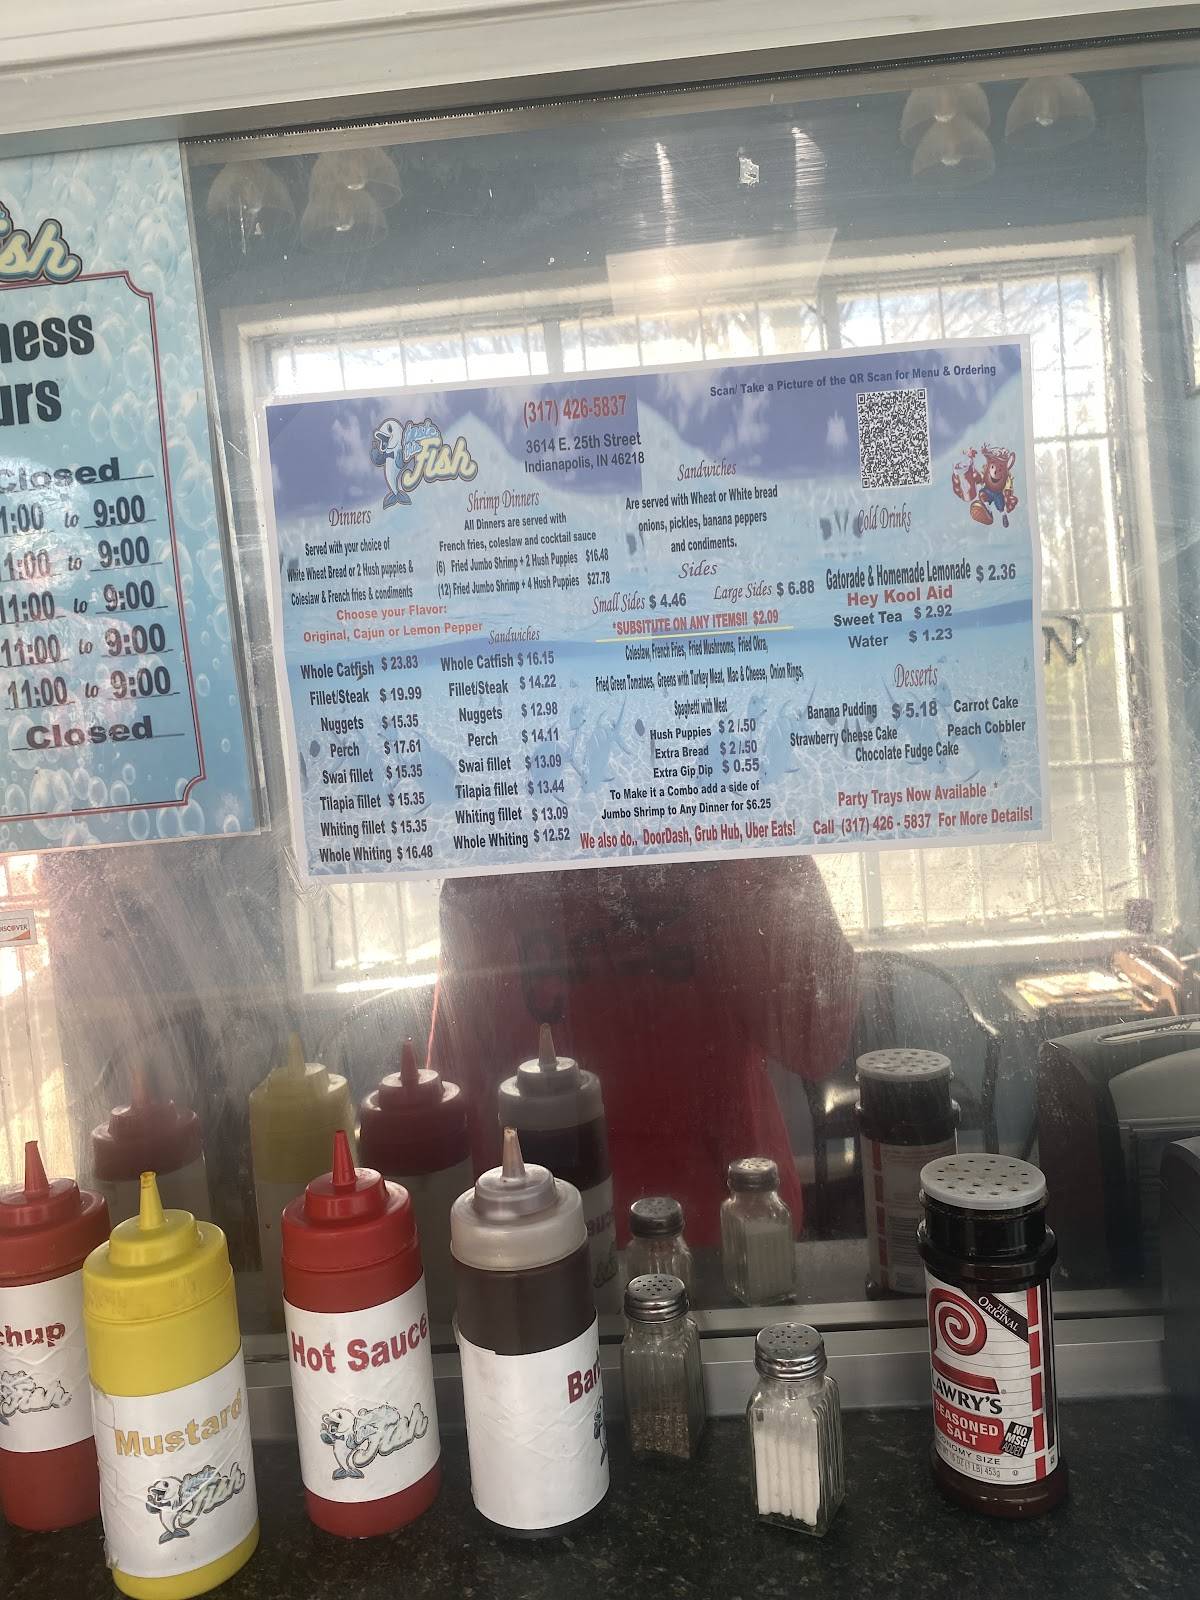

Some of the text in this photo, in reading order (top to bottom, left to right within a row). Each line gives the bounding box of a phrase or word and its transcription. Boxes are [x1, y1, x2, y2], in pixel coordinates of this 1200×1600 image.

[710, 364, 997, 396] Scan/ Take Picture Scan Menu Ordering
[524, 395, 626, 428] (317) 426-5837
[526, 432, 642, 454] 3614 25th Street
[525, 452, 644, 472] Indianapolis, 46218
[677, 458, 737, 481] Sandwiches
[467, 489, 540, 515] Shrimp Dinners
[642, 485, 778, 508] served Wheat White bread
[64, 512, 80, 528] to
[93, 495, 146, 527] 9:00
[328, 506, 372, 526] Dinners
[477, 514, 548, 529] Dinners served
[880, 503, 912, 533] Drinks
[439, 531, 596, 551] French fries, coleslaw cocktail sauce
[68, 555, 82, 571] to
[98, 536, 150, 568] 9:00
[678, 560, 718, 579] Sides
[826, 558, 971, 591] Gatorade Homemade Lemonade
[74, 598, 88, 614] to
[104, 580, 155, 612] 9:00
[592, 590, 645, 614] Small Sides
[714, 581, 772, 603] Large Sides
[847, 584, 953, 608] Hey Kool Aid
[337, 605, 447, 621] Choose Flavor:
[690, 615, 710, 630] ANY
[712, 612, 748, 628] ITEMS!!
[753, 609, 779, 626] $2.09
[833, 611, 903, 627] Sweet Tea
[78, 639, 93, 655] to
[105, 623, 166, 657] 9:00
[303, 622, 483, 644] Original, Cajun Lemon Pepper
[488, 625, 540, 645] Sandwiches
[848, 634, 889, 648] Water
[300, 661, 374, 679] Whole Catfish
[440, 653, 513, 671] Whole Catfish
[894, 664, 938, 688] Desserts
[8, 666, 171, 709] 11:00 to 9:00
[310, 688, 370, 705] Fillet/Steak
[449, 680, 509, 697] Fillet/Steak
[459, 706, 502, 724] Nuggets
[807, 696, 1019, 719] Banana Pudding Carrot Cake
[26, 715, 153, 749] Closed
[321, 716, 364, 734] Nuggets
[650, 727, 711, 740] Hush Puppies
[947, 719, 1026, 737] Peach Cobbler
[468, 732, 498, 747] Perch
[790, 726, 898, 747] Strawberry Cheese Cake
[330, 742, 359, 758] Perch
[856, 742, 959, 762] Chocolate Fudge Cake
[458, 757, 511, 773] Swai fillet
[322, 768, 373, 784] Swai fillet
[455, 782, 518, 800] Tilapia fillet
[838, 783, 986, 808] Party Trays Now Available
[320, 794, 381, 813] Tilapia fillet
[455, 807, 522, 825] Whiting fillet
[813, 806, 1033, 837] Call (317) 426 5837 More Details!
[320, 820, 385, 838] Whiting fillet
[643, 819, 796, 846] DoorDash, Grub Hub, Uber Eats!
[453, 832, 528, 849] Whole Whiting
[319, 848, 392, 863] Whole Whiting
[978, 1297, 1019, 1331] ORIGINAL
[998, 1304, 1009, 1315] THE
[0, 1322, 66, 1347] hup
[291, 1312, 429, 1374] Hot Sauce
[114, 1388, 242, 1457] Mustard
[935, 1399, 998, 1436] SEASONED
[946, 1423, 978, 1446] SALT
[1005, 1433, 1028, 1447] MSG
[1013, 1425, 1028, 1436] NO
[1002, 1442, 1024, 1456] ADDED
[976, 1455, 1000, 1465] SIZE
